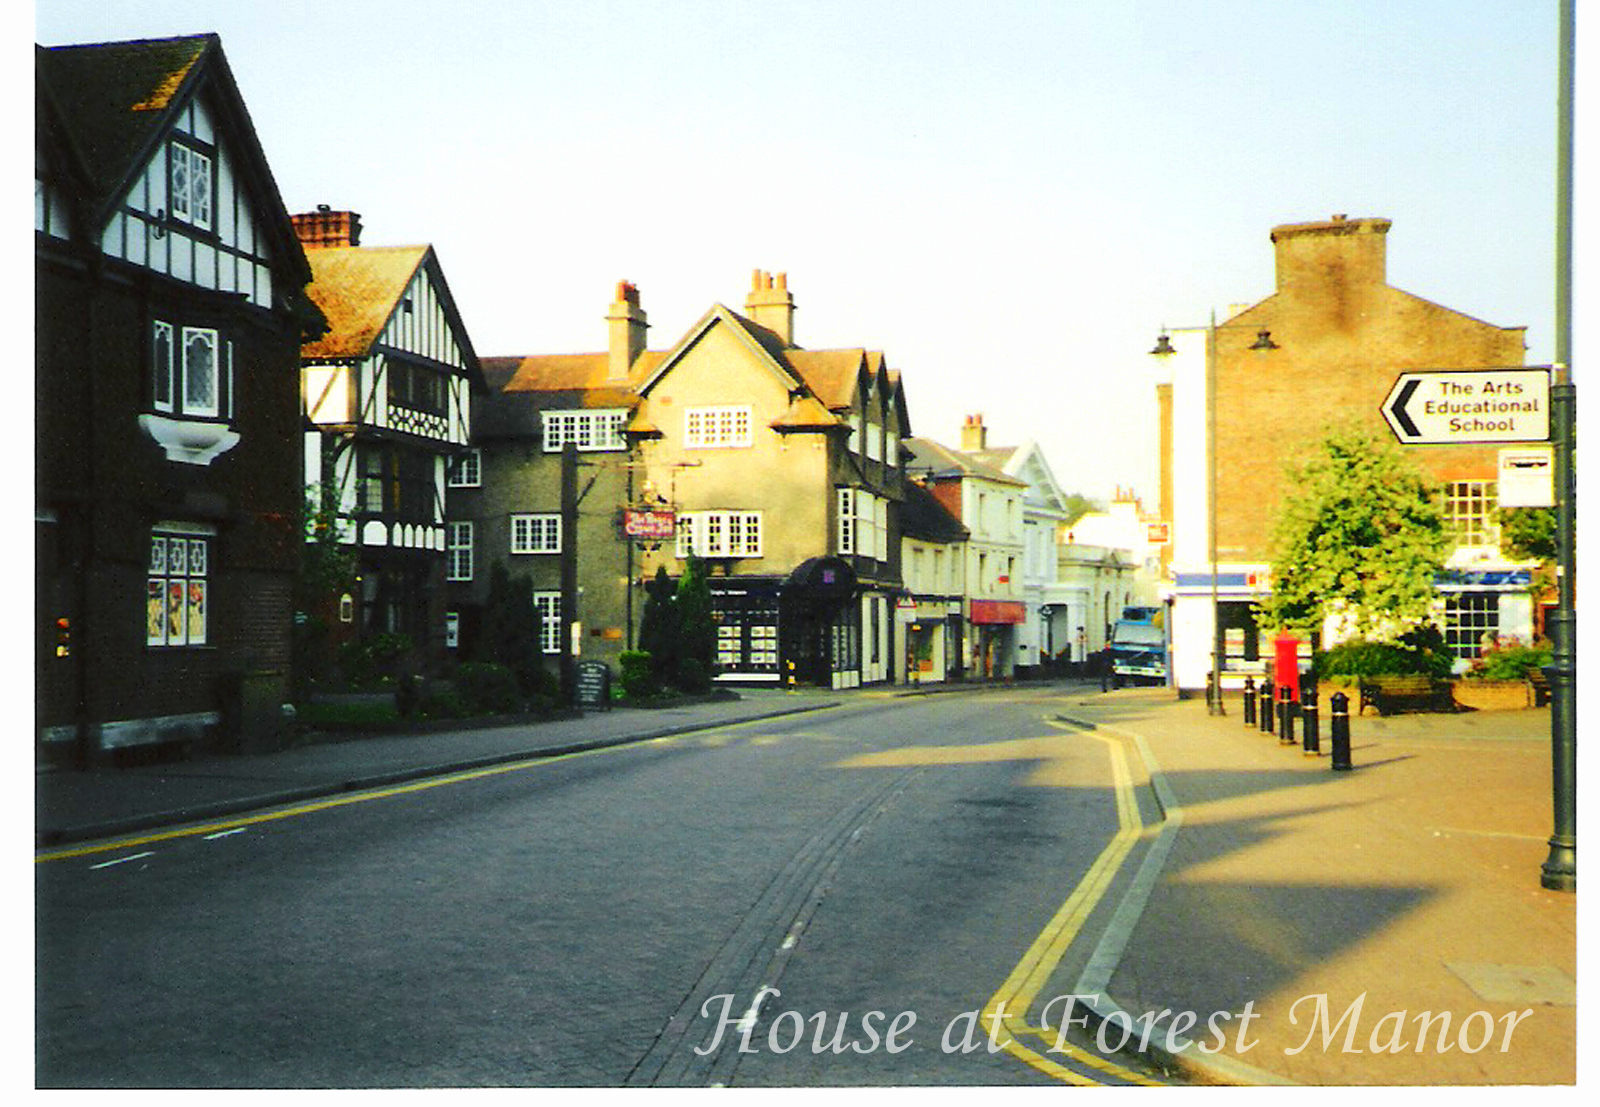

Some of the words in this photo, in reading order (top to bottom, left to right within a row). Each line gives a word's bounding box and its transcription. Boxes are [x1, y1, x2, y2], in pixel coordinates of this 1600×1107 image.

[1440, 381, 1473, 395] The
[1483, 381, 1524, 394] Arts
[1424, 399, 1539, 415] Educational
[1449, 418, 1515, 432] School
